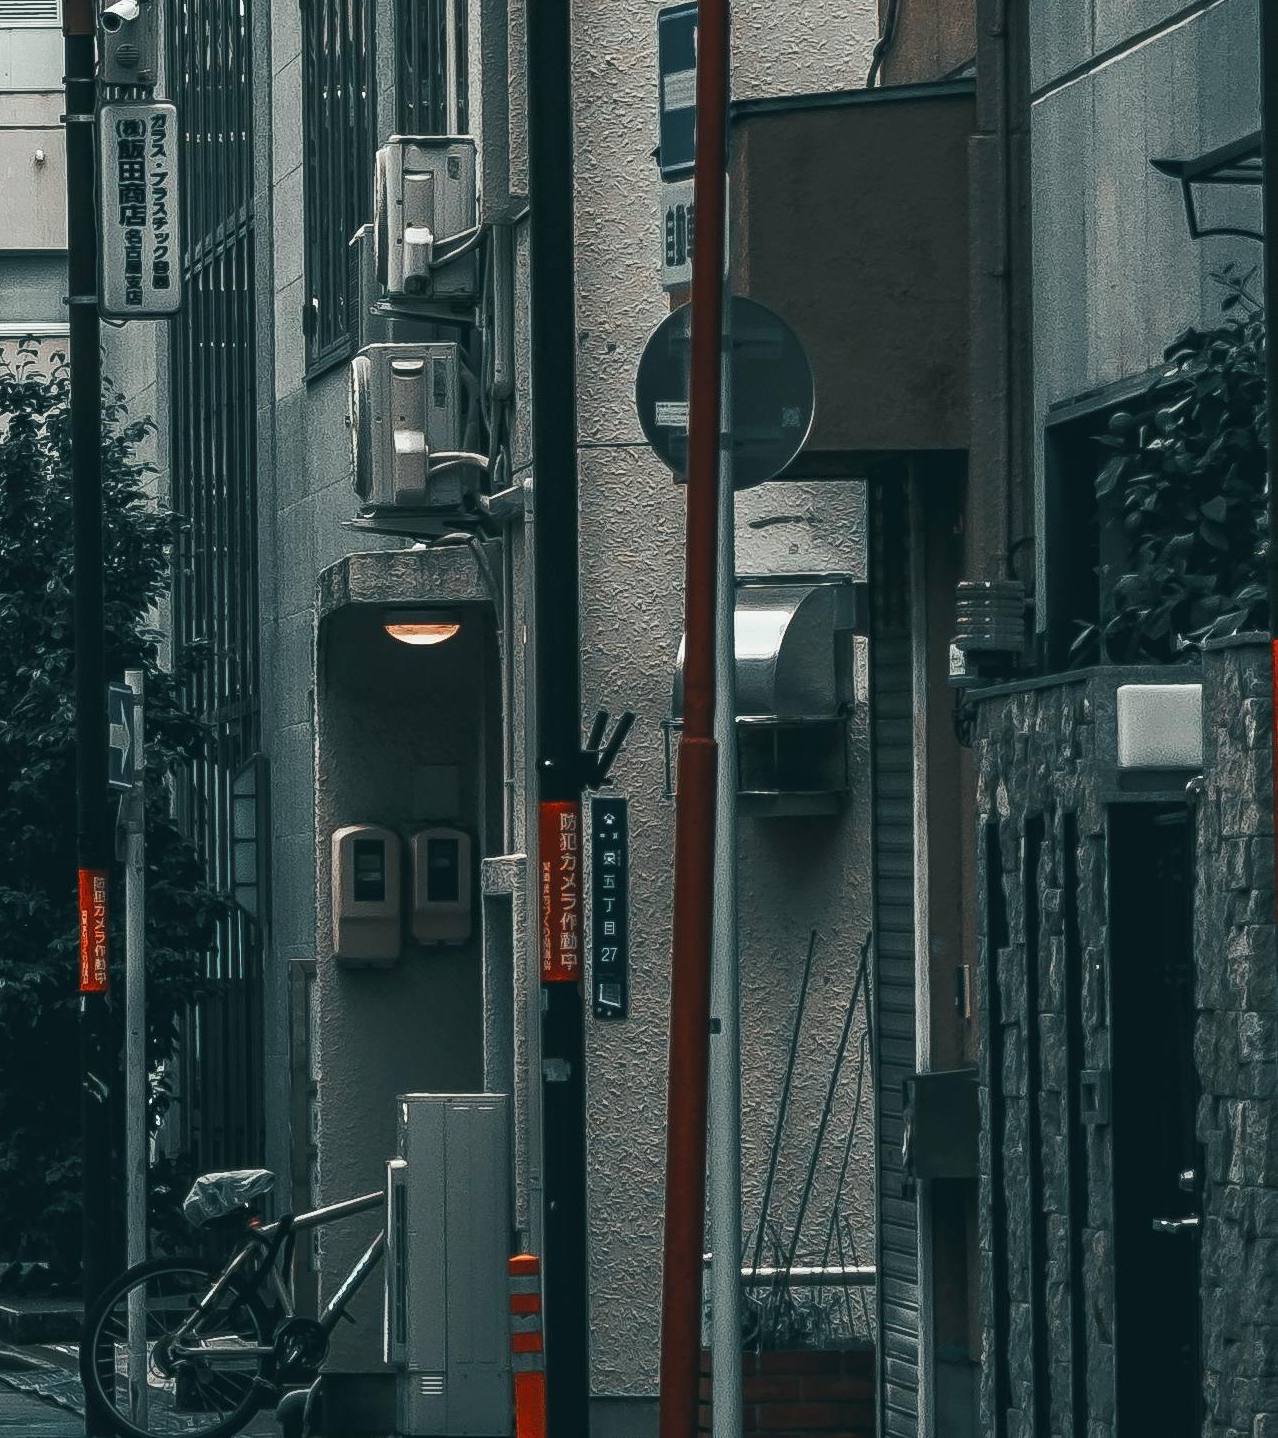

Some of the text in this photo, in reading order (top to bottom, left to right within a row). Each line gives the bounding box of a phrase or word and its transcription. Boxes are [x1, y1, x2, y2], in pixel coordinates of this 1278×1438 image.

[560, 812, 577, 971] 防犯カメラ作動中
